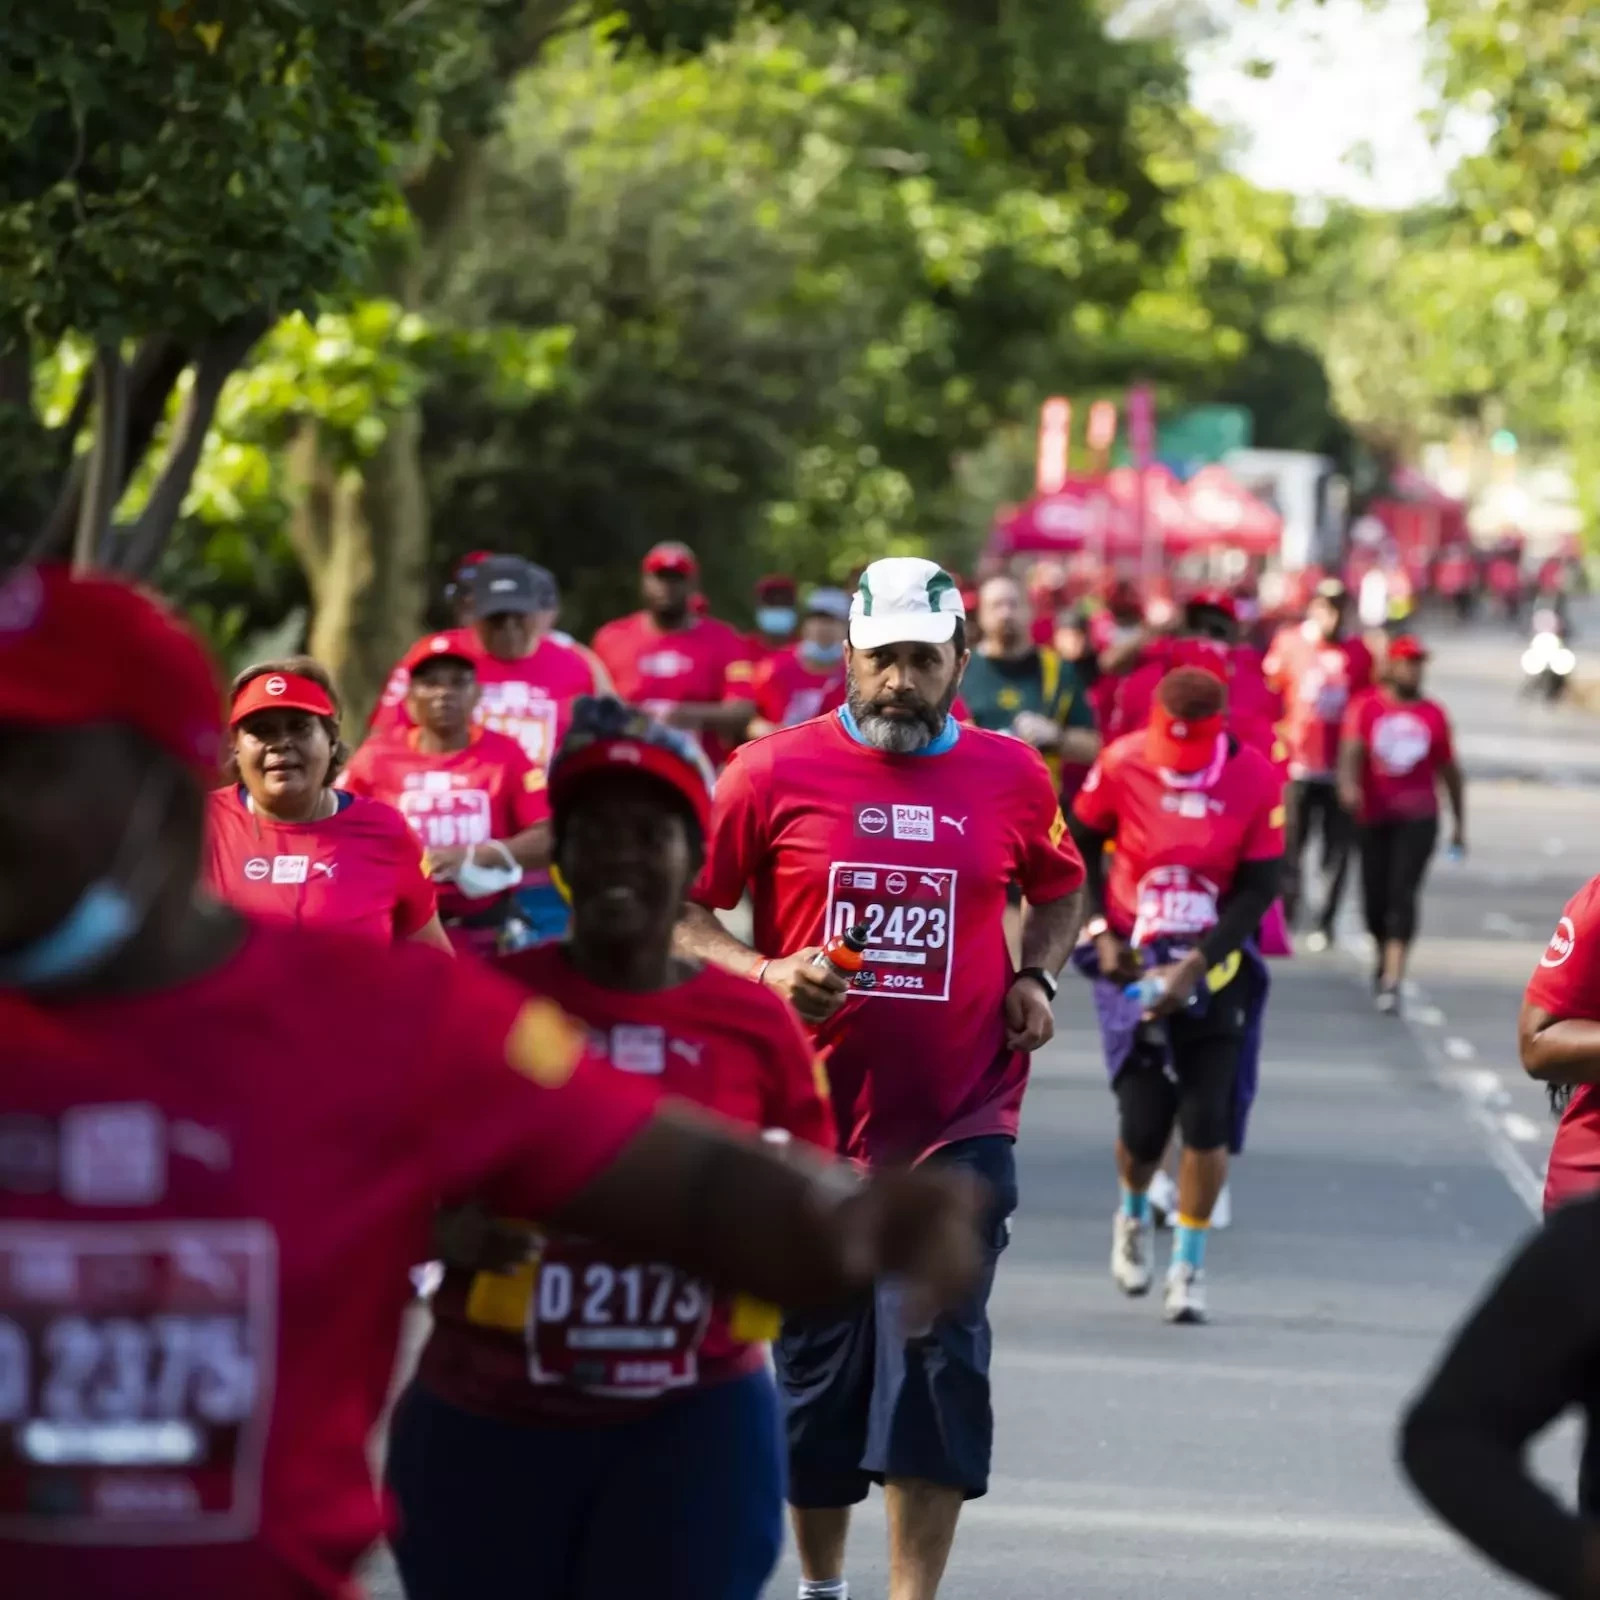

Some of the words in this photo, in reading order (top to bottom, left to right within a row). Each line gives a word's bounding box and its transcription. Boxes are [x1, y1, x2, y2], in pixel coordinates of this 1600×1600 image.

[896, 808, 929, 821] RUN
[897, 826, 929, 836] SERIES
[864, 902, 946, 949] 2423
[855, 971, 876, 981] ASA
[883, 974, 925, 989] 2021
[582, 1263, 702, 1325] 2173
[44, 1316, 255, 1421] 2375
